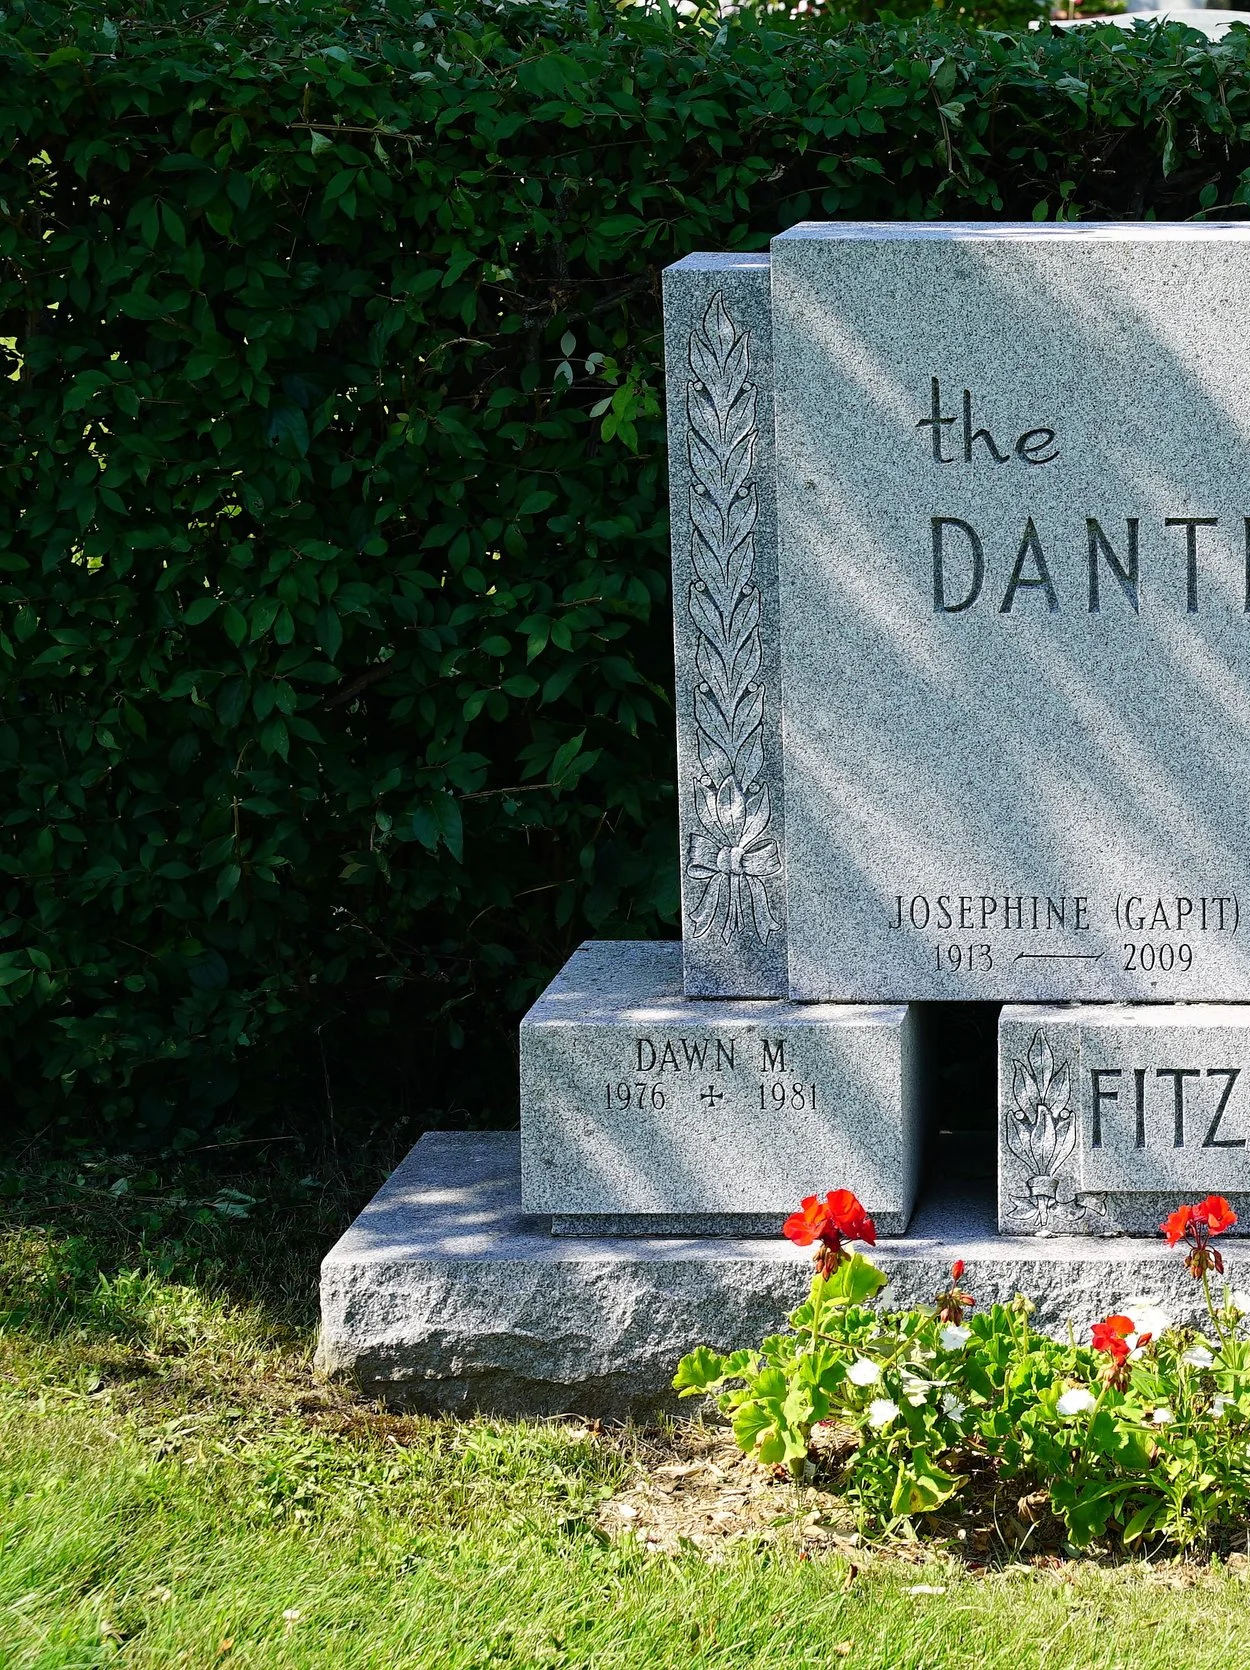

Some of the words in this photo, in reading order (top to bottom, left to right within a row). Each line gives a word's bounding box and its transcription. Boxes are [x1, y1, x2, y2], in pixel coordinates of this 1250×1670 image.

[915, 376, 1060, 465] the
[888, 895, 1091, 931] JOSEPHINE
[1115, 891, 1240, 936] (GAPIT)
[934, 944, 994, 972] 1913
[1123, 943, 1193, 972] 2009
[636, 1038, 737, 1073] DAWN
[760, 1038, 796, 1073] M.
[604, 1082, 666, 1110] 1976
[758, 1082, 819, 1110] 1981
